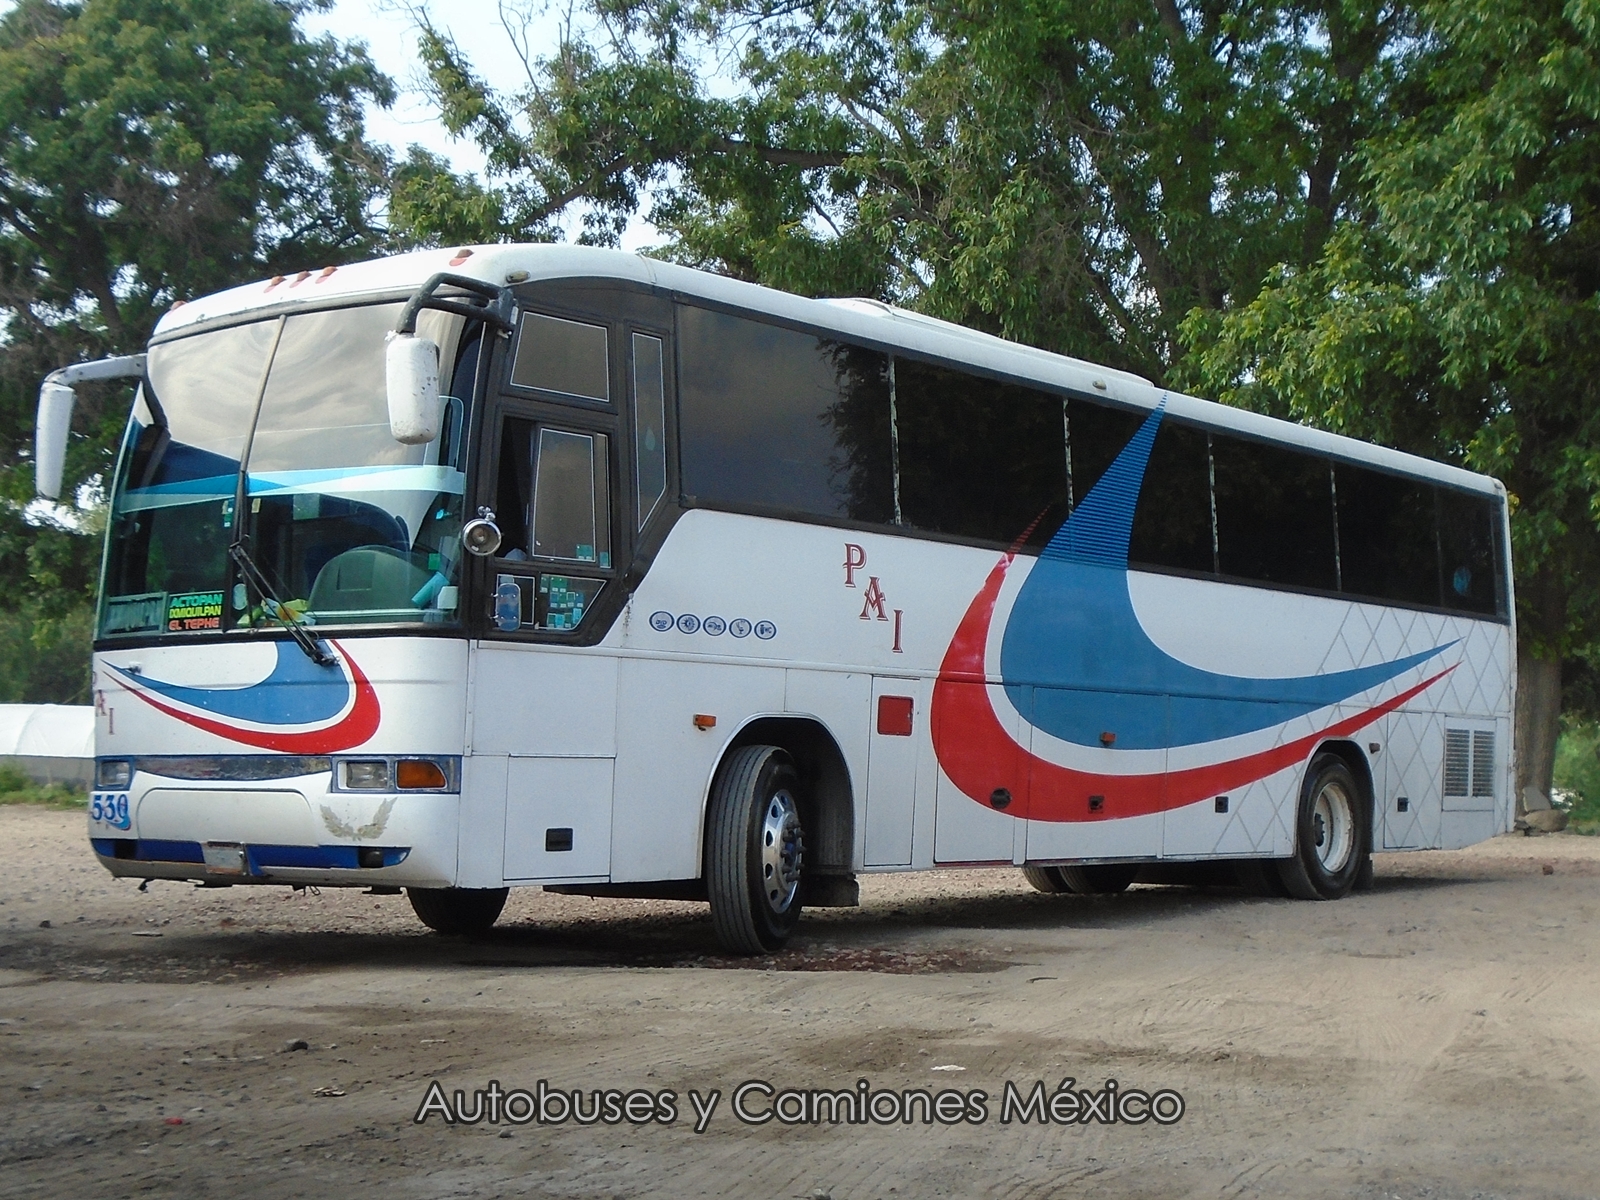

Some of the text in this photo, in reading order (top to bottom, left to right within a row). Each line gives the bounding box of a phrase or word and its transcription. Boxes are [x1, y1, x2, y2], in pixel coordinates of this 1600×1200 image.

[169, 593, 223, 608] ACTOPAN
[842, 543, 904, 654] PAI
[169, 617, 220, 631] EL TEPHE
[92, 794, 128, 820] 530
